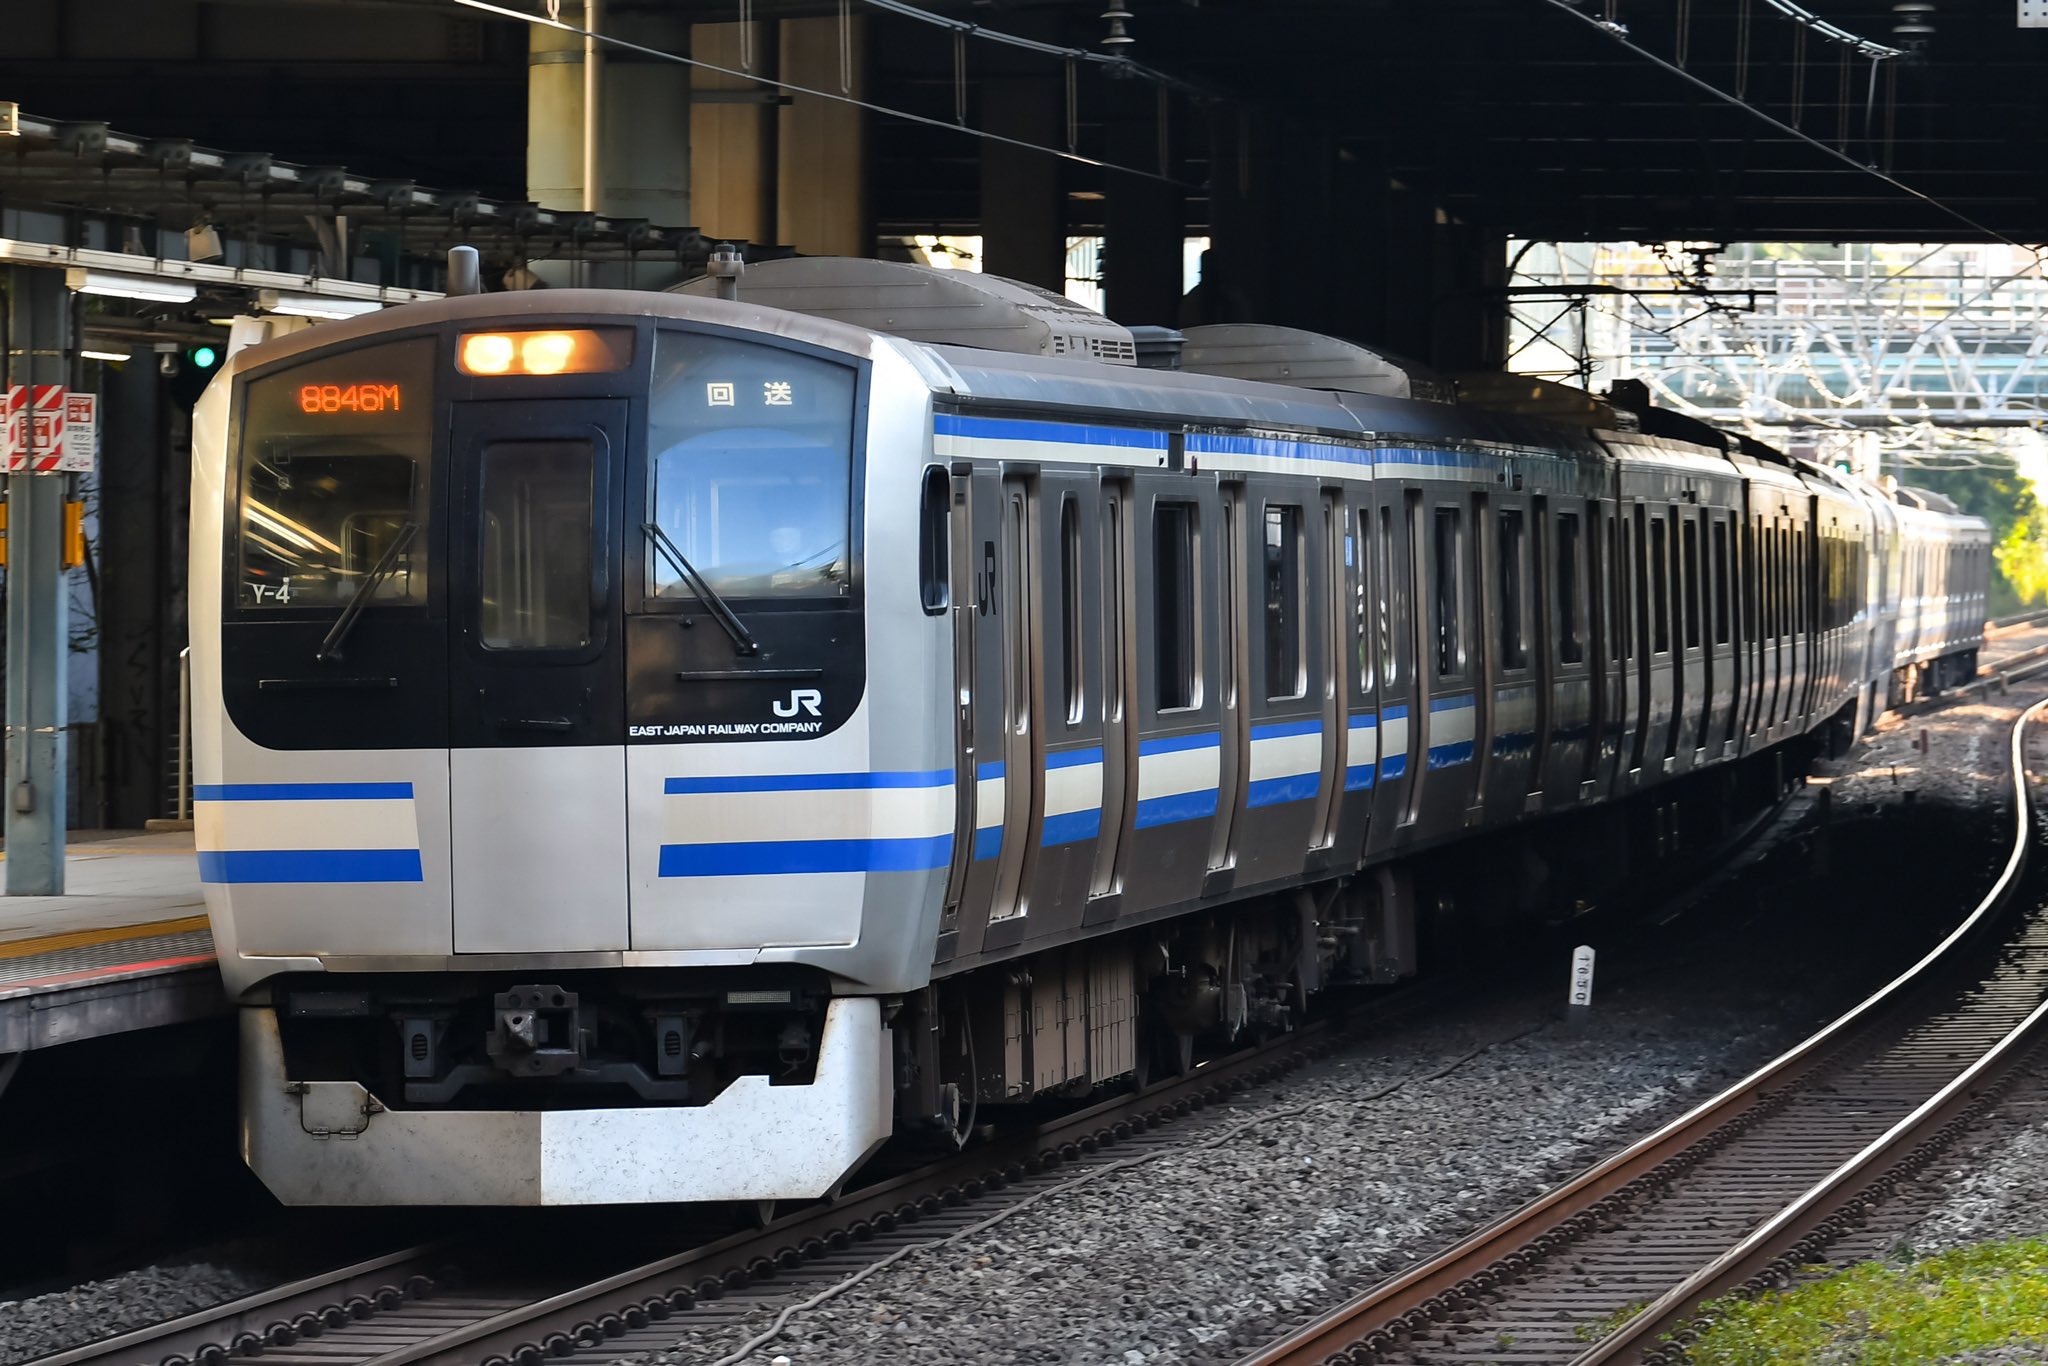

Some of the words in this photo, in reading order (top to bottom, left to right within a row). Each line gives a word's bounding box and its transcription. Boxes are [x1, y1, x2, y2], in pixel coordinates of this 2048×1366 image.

[300, 384, 400, 412] 8846M
[706, 382, 793, 407] 回送
[20, 417, 48, 427] SOP
[978, 541, 996, 616] JR
[252, 584, 290, 604] Y-4
[773, 689, 822, 717] JR
[629, 725, 664, 736] EAST
[664, 724, 706, 735] JAPAN
[707, 723, 759, 735] RAILWAY
[760, 722, 822, 734] COMPANY
